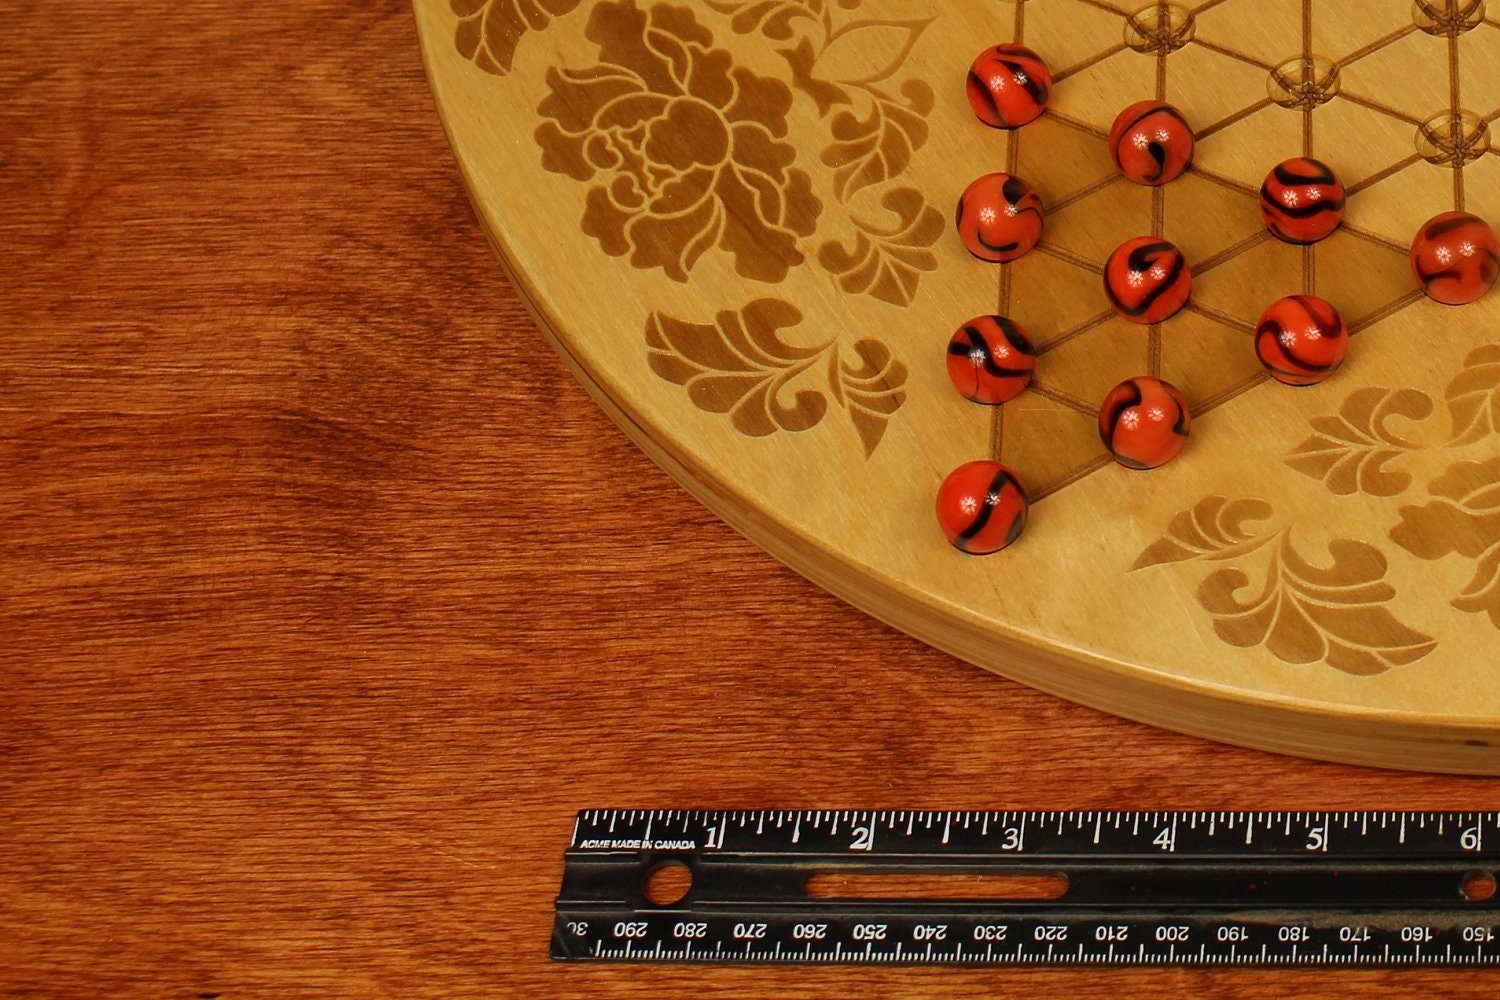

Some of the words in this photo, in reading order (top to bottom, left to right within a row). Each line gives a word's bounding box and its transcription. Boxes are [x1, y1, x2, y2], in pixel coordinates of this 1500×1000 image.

[580, 840, 611, 848] ACME
[612, 840, 641, 849] MADE
[642, 840, 653, 849] IN
[654, 840, 695, 849] CANADA
[703, 827, 720, 848] 1
[849, 826, 870, 850] 2
[1001, 827, 1020, 850] 3
[1152, 827, 1171, 849] 4
[1305, 827, 1324, 849] 5
[1460, 827, 1477, 849] 6
[613, 923, 648, 941] 290
[673, 923, 708, 941] 280
[733, 923, 767, 941] 270
[793, 923, 828, 941] 260
[852, 923, 887, 941] 250
[913, 923, 947, 941] 240
[974, 923, 1007, 941] 230
[1034, 924, 1067, 942] 220
[1095, 924, 1128, 942] 210
[1155, 924, 1189, 942] 200
[1217, 924, 1248, 942] 190
[1278, 924, 1310, 942] 180
[1339, 924, 1371, 942] 170
[1401, 924, 1433, 942] 160
[1462, 924, 1495, 942] 150
